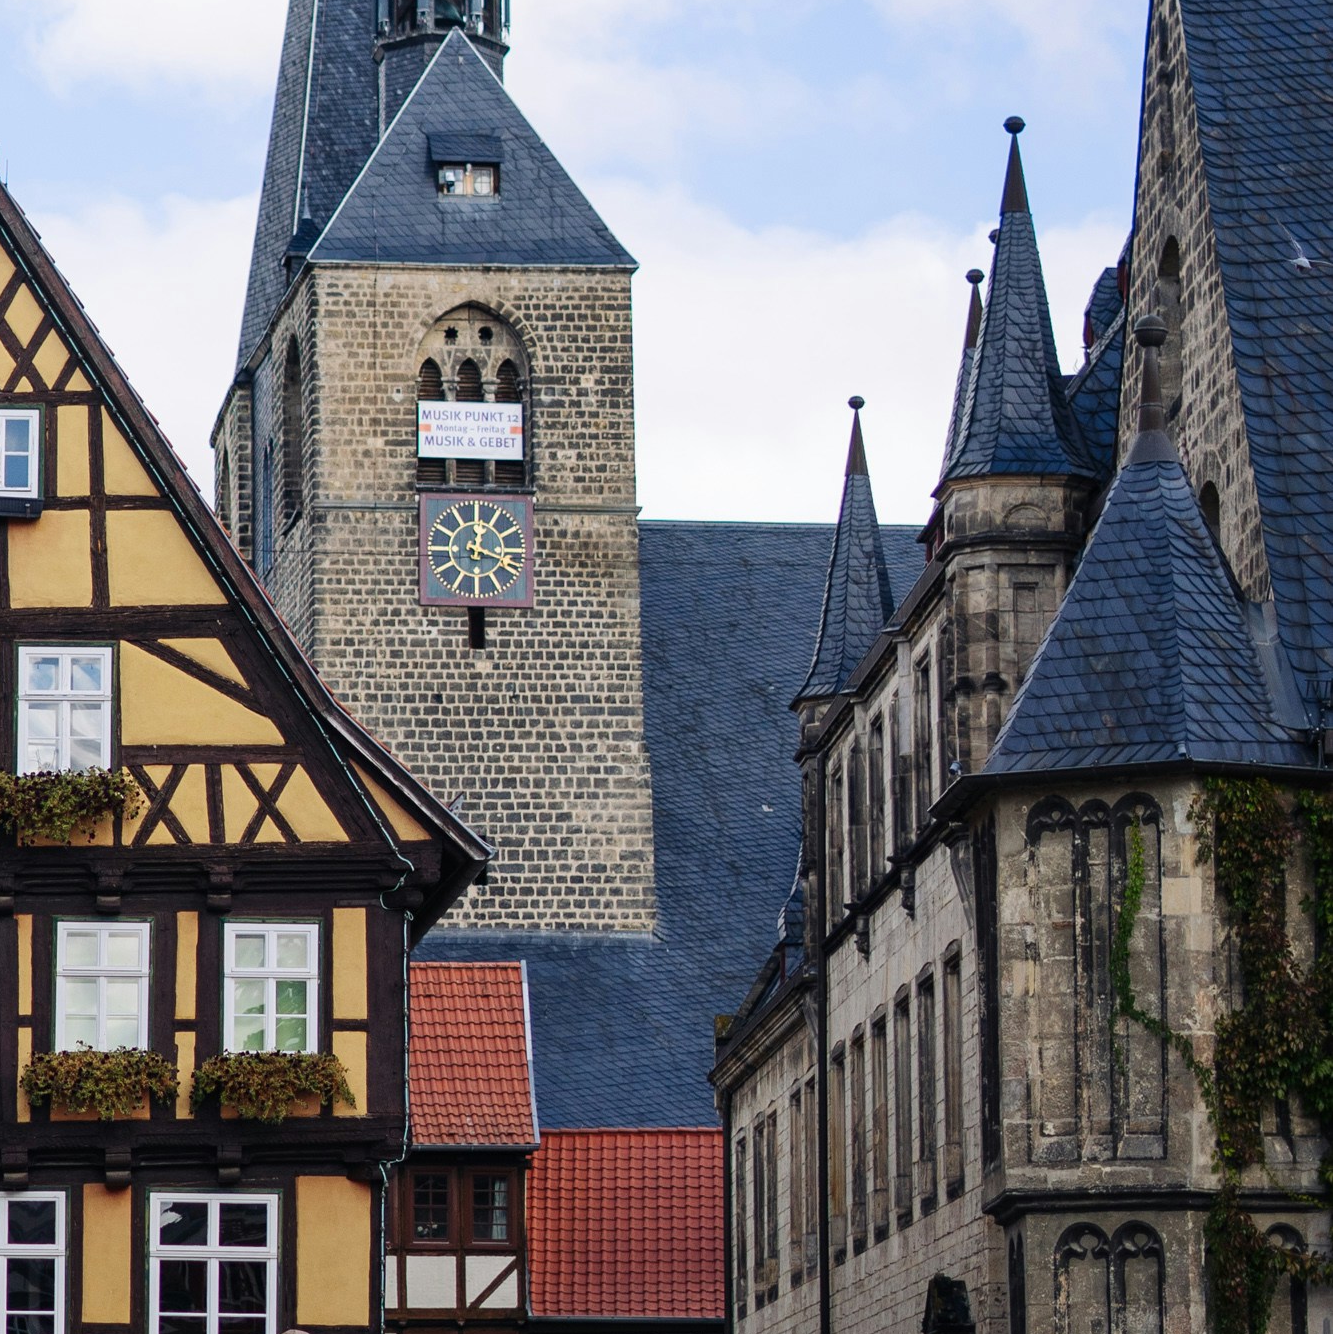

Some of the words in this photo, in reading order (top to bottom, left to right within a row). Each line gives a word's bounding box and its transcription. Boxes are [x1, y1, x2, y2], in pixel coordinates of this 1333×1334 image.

[421, 410, 462, 421] MUSIK
[465, 411, 504, 422] PUNKT
[507, 414, 519, 423] 12
[436, 424, 467, 434] Montag
[477, 425, 505, 435] Freitag
[424, 436, 464, 447] MUSIK
[467, 437, 476, 447] &
[479, 437, 517, 448] GEBET
